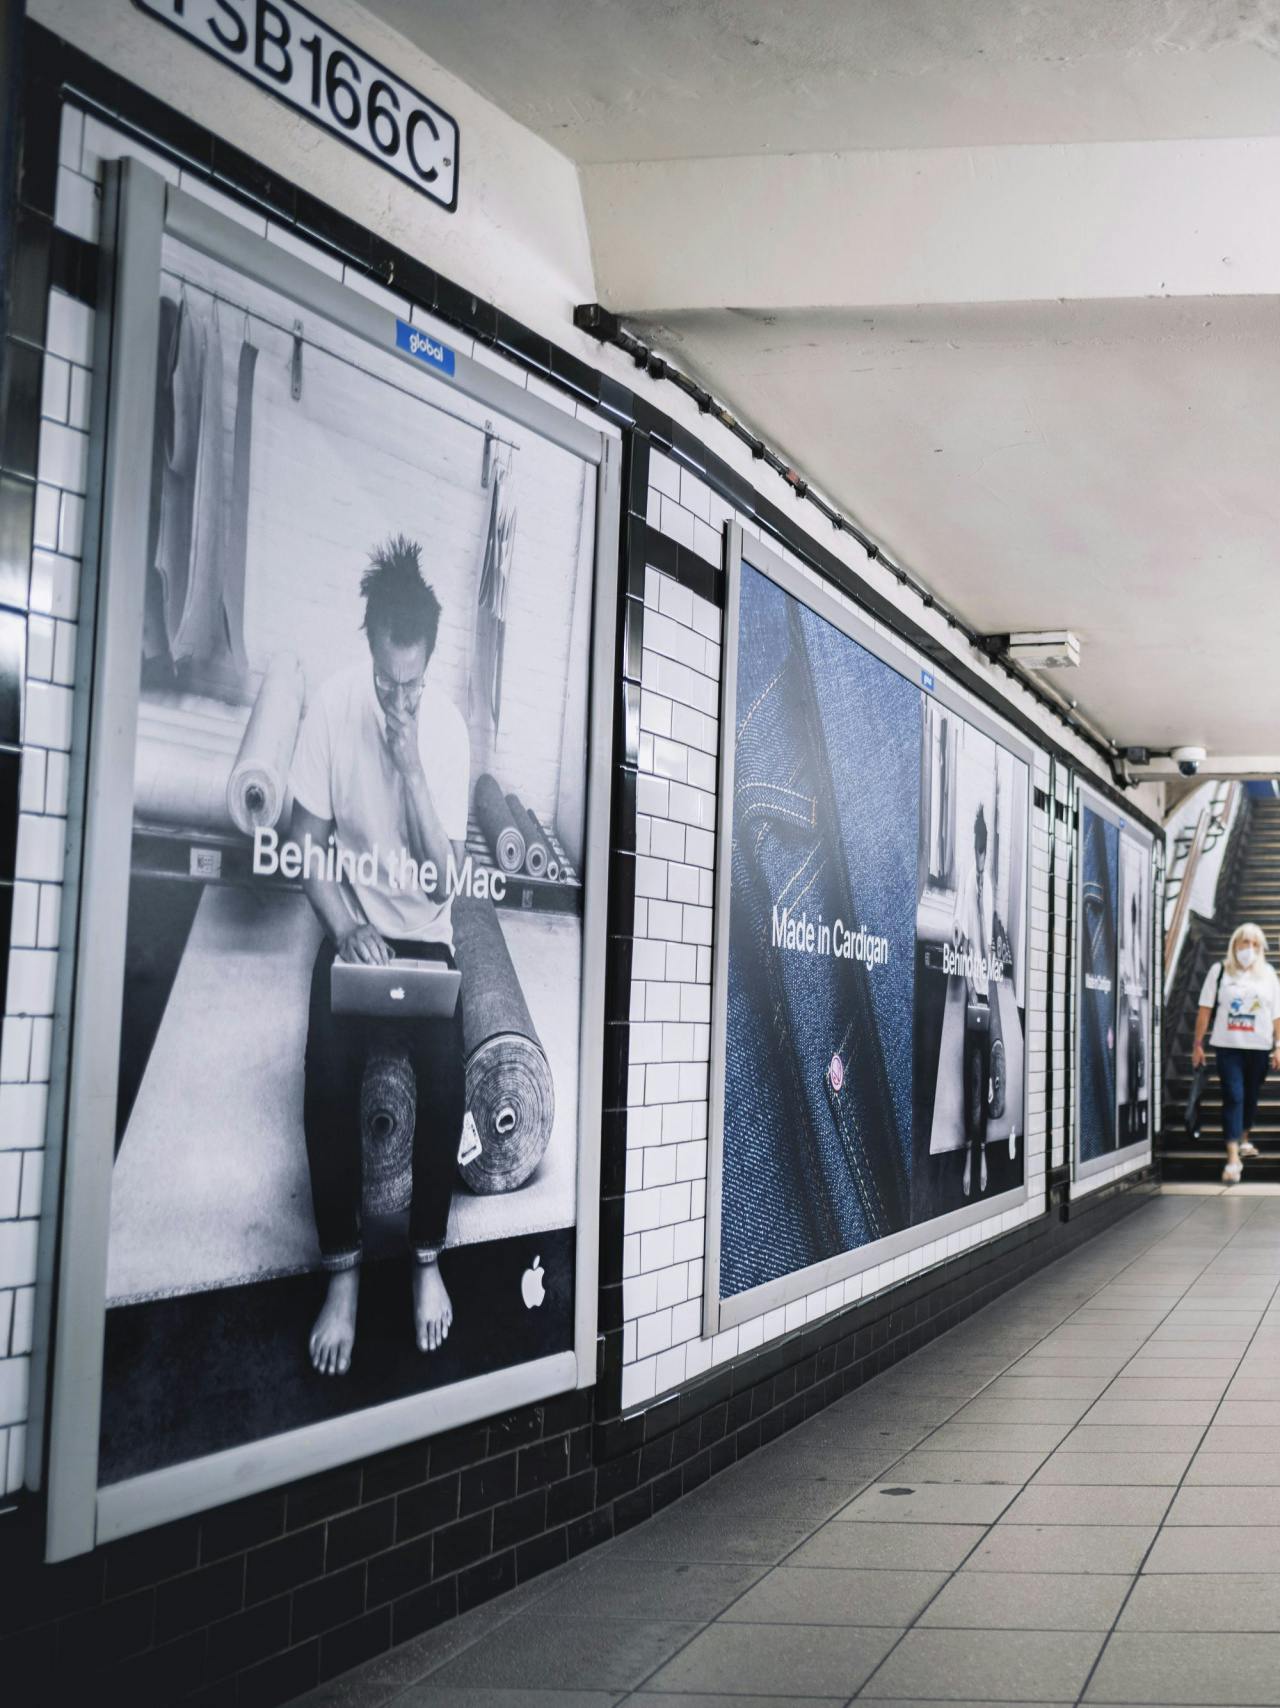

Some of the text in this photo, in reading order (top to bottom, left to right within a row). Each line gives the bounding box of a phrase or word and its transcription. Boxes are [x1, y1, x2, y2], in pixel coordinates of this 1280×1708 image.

[172, 0, 440, 183] SB166C
[409, 332, 443, 363] global
[252, 825, 507, 901] Behind the Mac
[772, 904, 888, 971] Made in Cardigan
[943, 942, 973, 978] Behind
